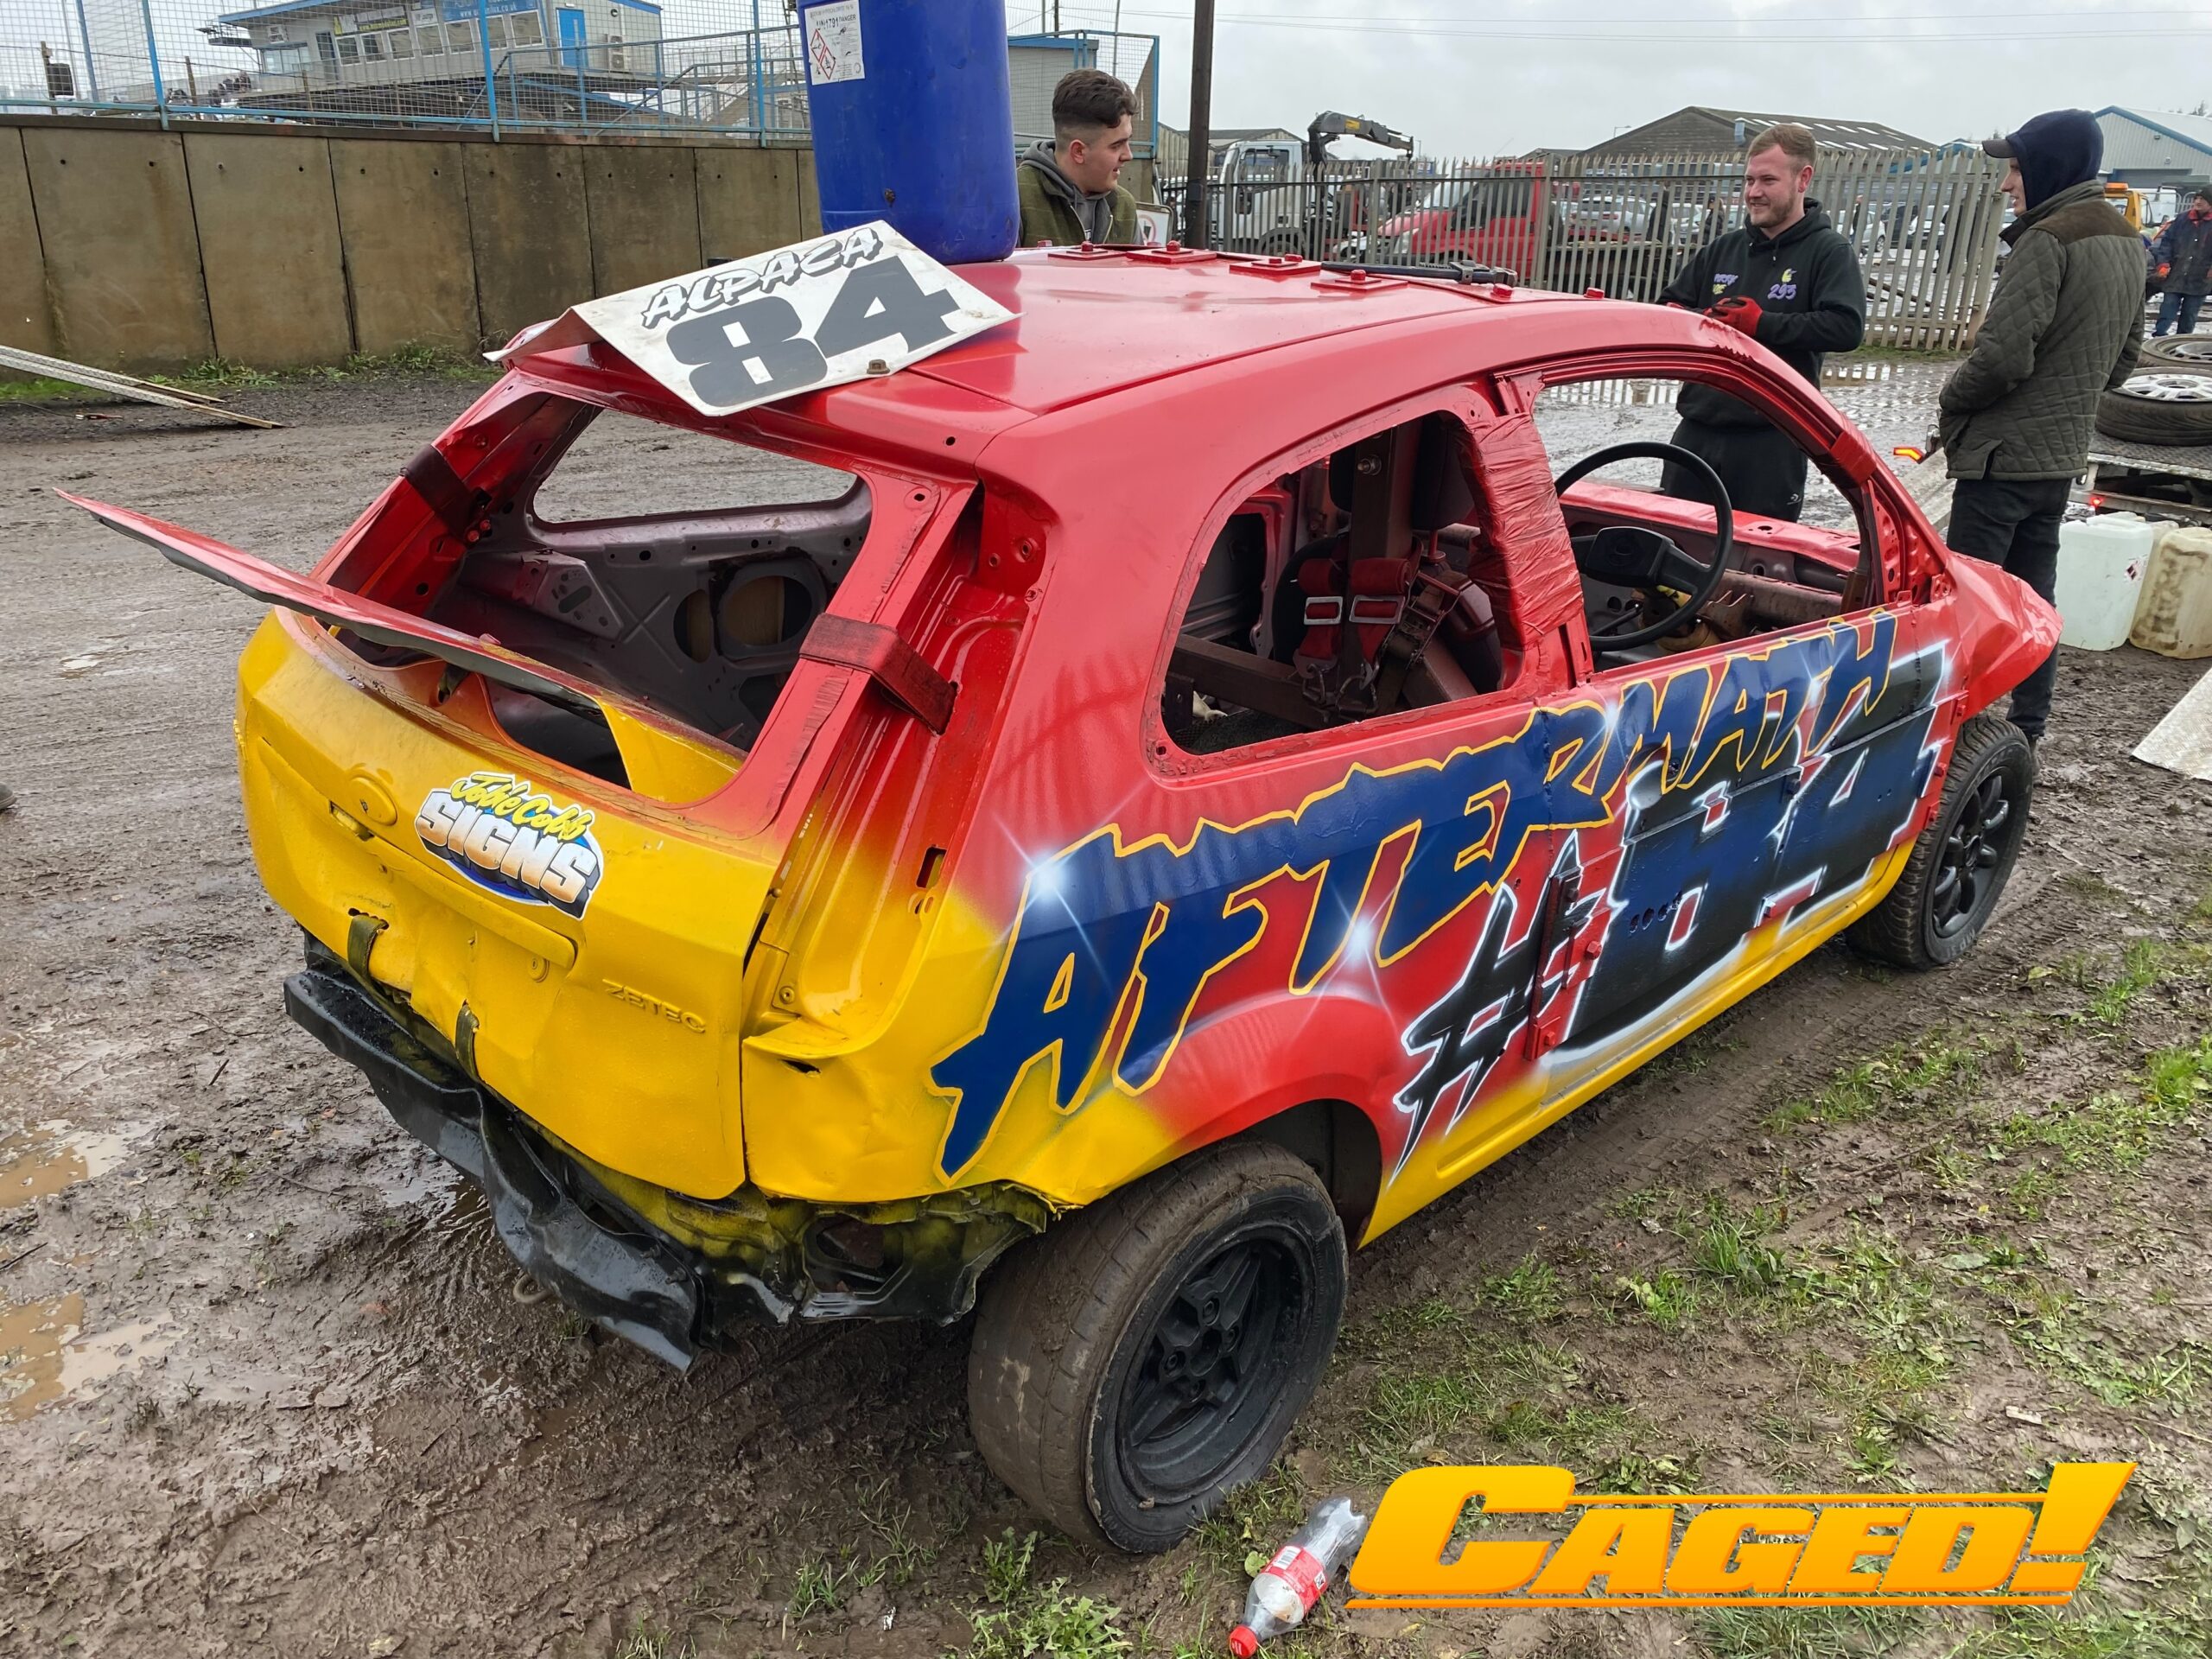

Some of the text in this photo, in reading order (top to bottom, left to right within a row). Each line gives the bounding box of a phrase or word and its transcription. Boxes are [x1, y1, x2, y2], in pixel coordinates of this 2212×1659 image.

[641, 226, 884, 329] ALPACA
[666, 255, 960, 407] 84
[416, 790, 600, 916] SIGNS
[512, 796, 593, 842] Cobb
[929, 609, 1899, 1186] AFTERMATH
[602, 978, 707, 1033] ZETEC
